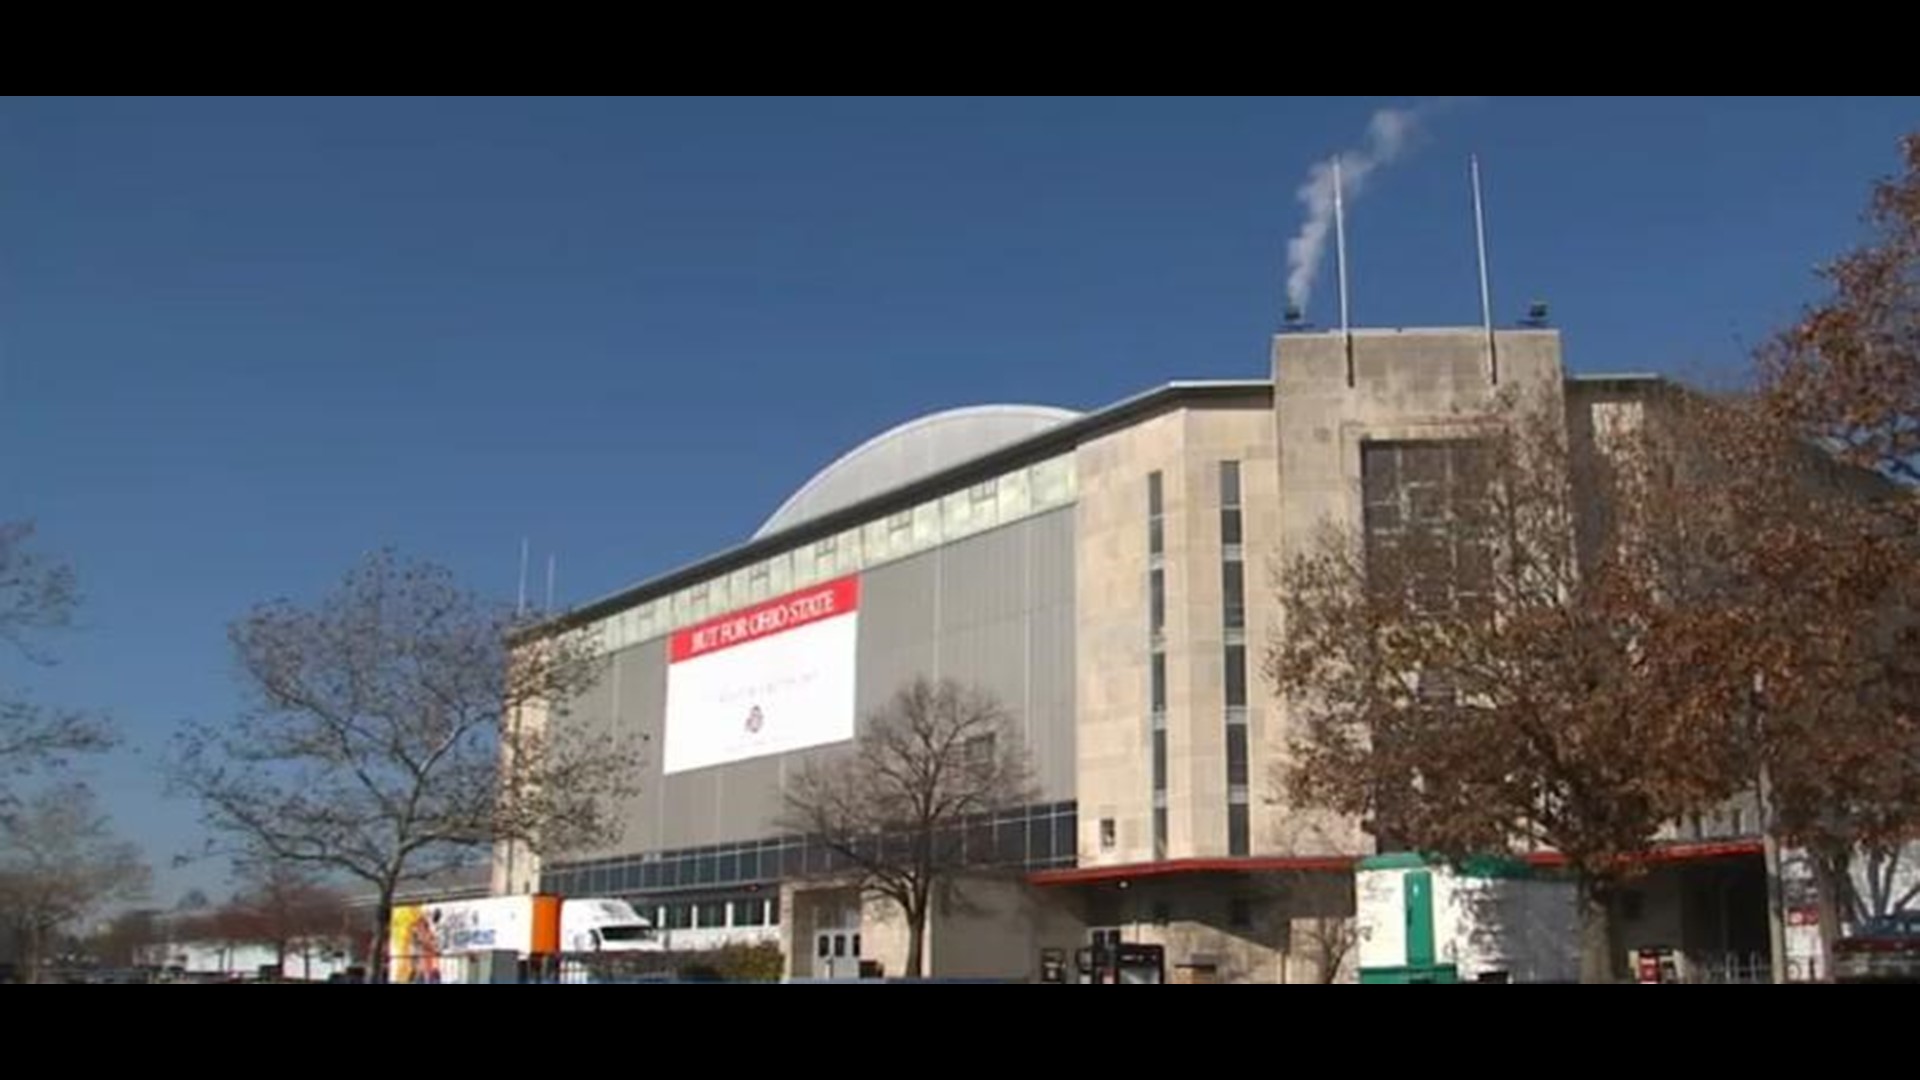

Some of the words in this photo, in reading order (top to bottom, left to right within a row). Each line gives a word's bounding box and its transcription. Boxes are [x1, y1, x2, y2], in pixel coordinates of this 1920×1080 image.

[719, 617, 748, 645] FOR
[748, 605, 788, 636] OHIO
[789, 590, 834, 622] STATE
